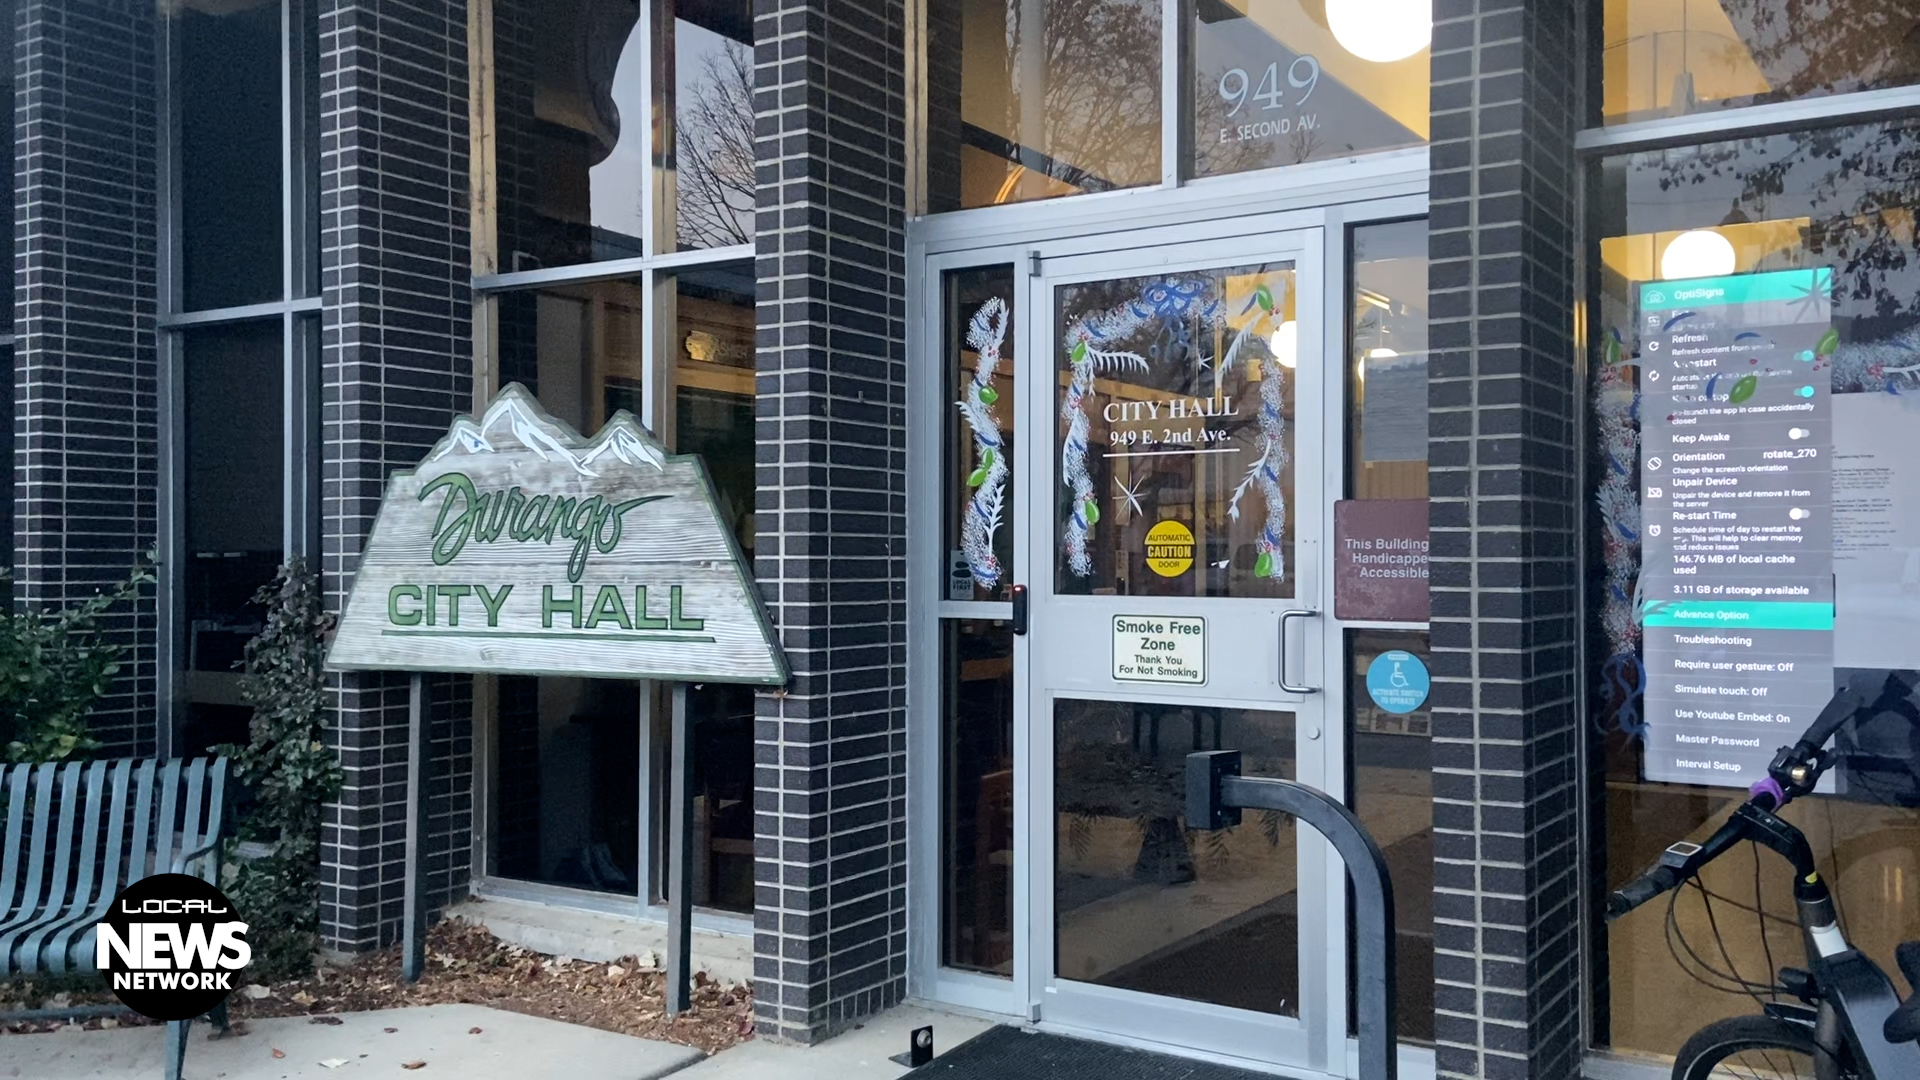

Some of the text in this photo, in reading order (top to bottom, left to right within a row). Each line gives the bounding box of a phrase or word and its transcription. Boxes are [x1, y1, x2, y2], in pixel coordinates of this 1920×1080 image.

[1219, 55, 1319, 117] 949
[1220, 114, 1320, 143] E. SECOND AV.
[1674, 287, 1725, 301] OptiSigns
[1672, 347, 1700, 357] Refresh
[1701, 346, 1730, 355] content
[1103, 396, 1239, 423] CITY HALL
[1709, 406, 1722, 415] the
[1723, 406, 1738, 416] app
[1739, 405, 1747, 413] in
[1748, 405, 1766, 413] case
[1767, 402, 1815, 413] accidentally
[1672, 417, 1697, 425] closed
[1110, 427, 1231, 446] 949 E. 2nd Ave.
[1672, 432, 1730, 444] Keep Awake
[1672, 448, 1817, 462] Orientation rotate_270
[1672, 464, 1788, 475] Change the screen's orientation
[1672, 476, 1738, 488] Unpair Device
[1672, 491, 1697, 500] Unpair
[1698, 490, 1710, 499] the
[1711, 490, 1736, 499] device
[1737, 490, 1752, 498] and
[1753, 489, 1783, 498] remove
[1791, 488, 1811, 497] from
[1672, 500, 1709, 508] the server
[1672, 510, 1737, 520] Re-start Time
[418, 472, 673, 583] Durango
[1672, 526, 1707, 534] Schedule
[1708, 525, 1725, 534] time
[1726, 525, 1735, 533] of
[1736, 525, 1751, 535] day
[1761, 525, 1787, 533] restart
[1788, 525, 1801, 533] the
[1147, 533, 1191, 542] AUTOMATIC
[1691, 534, 1707, 542] This
[1708, 534, 1721, 542] will
[1722, 534, 1739, 543] help
[1740, 534, 1749, 542] to
[1749, 534, 1769, 542] clear
[1770, 534, 1803, 543] memory
[1147, 545, 1192, 558] CAUTION
[1345, 538, 1429, 552] This Building
[1688, 543, 1714, 551] reduce
[1715, 543, 1740, 551] issues
[1352, 552, 1429, 566] Handicappe
[1673, 554, 1796, 564] 146.76 MB of local cache
[1360, 567, 1429, 578] Accessible
[1673, 565, 1697, 575] used
[1673, 584, 1810, 596] 3.11 GB of storage available
[388, 584, 704, 631] CITY HALL
[1673, 609, 1750, 621] Advance Option
[1116, 620, 1201, 635] Smoke Free
[1140, 637, 1176, 651] Zone
[1674, 634, 1752, 647] Troubleshooting
[1134, 654, 1183, 665] Thank You
[1674, 659, 1794, 672] Require user gesture: Off
[1119, 665, 1198, 679] For Not Smoking
[1674, 684, 1768, 697] Simulate touch: Off
[1675, 709, 1791, 723] Use Youtube Embed: On
[1675, 734, 1760, 747] Master Password
[1676, 758, 1742, 773] Interval Setup
